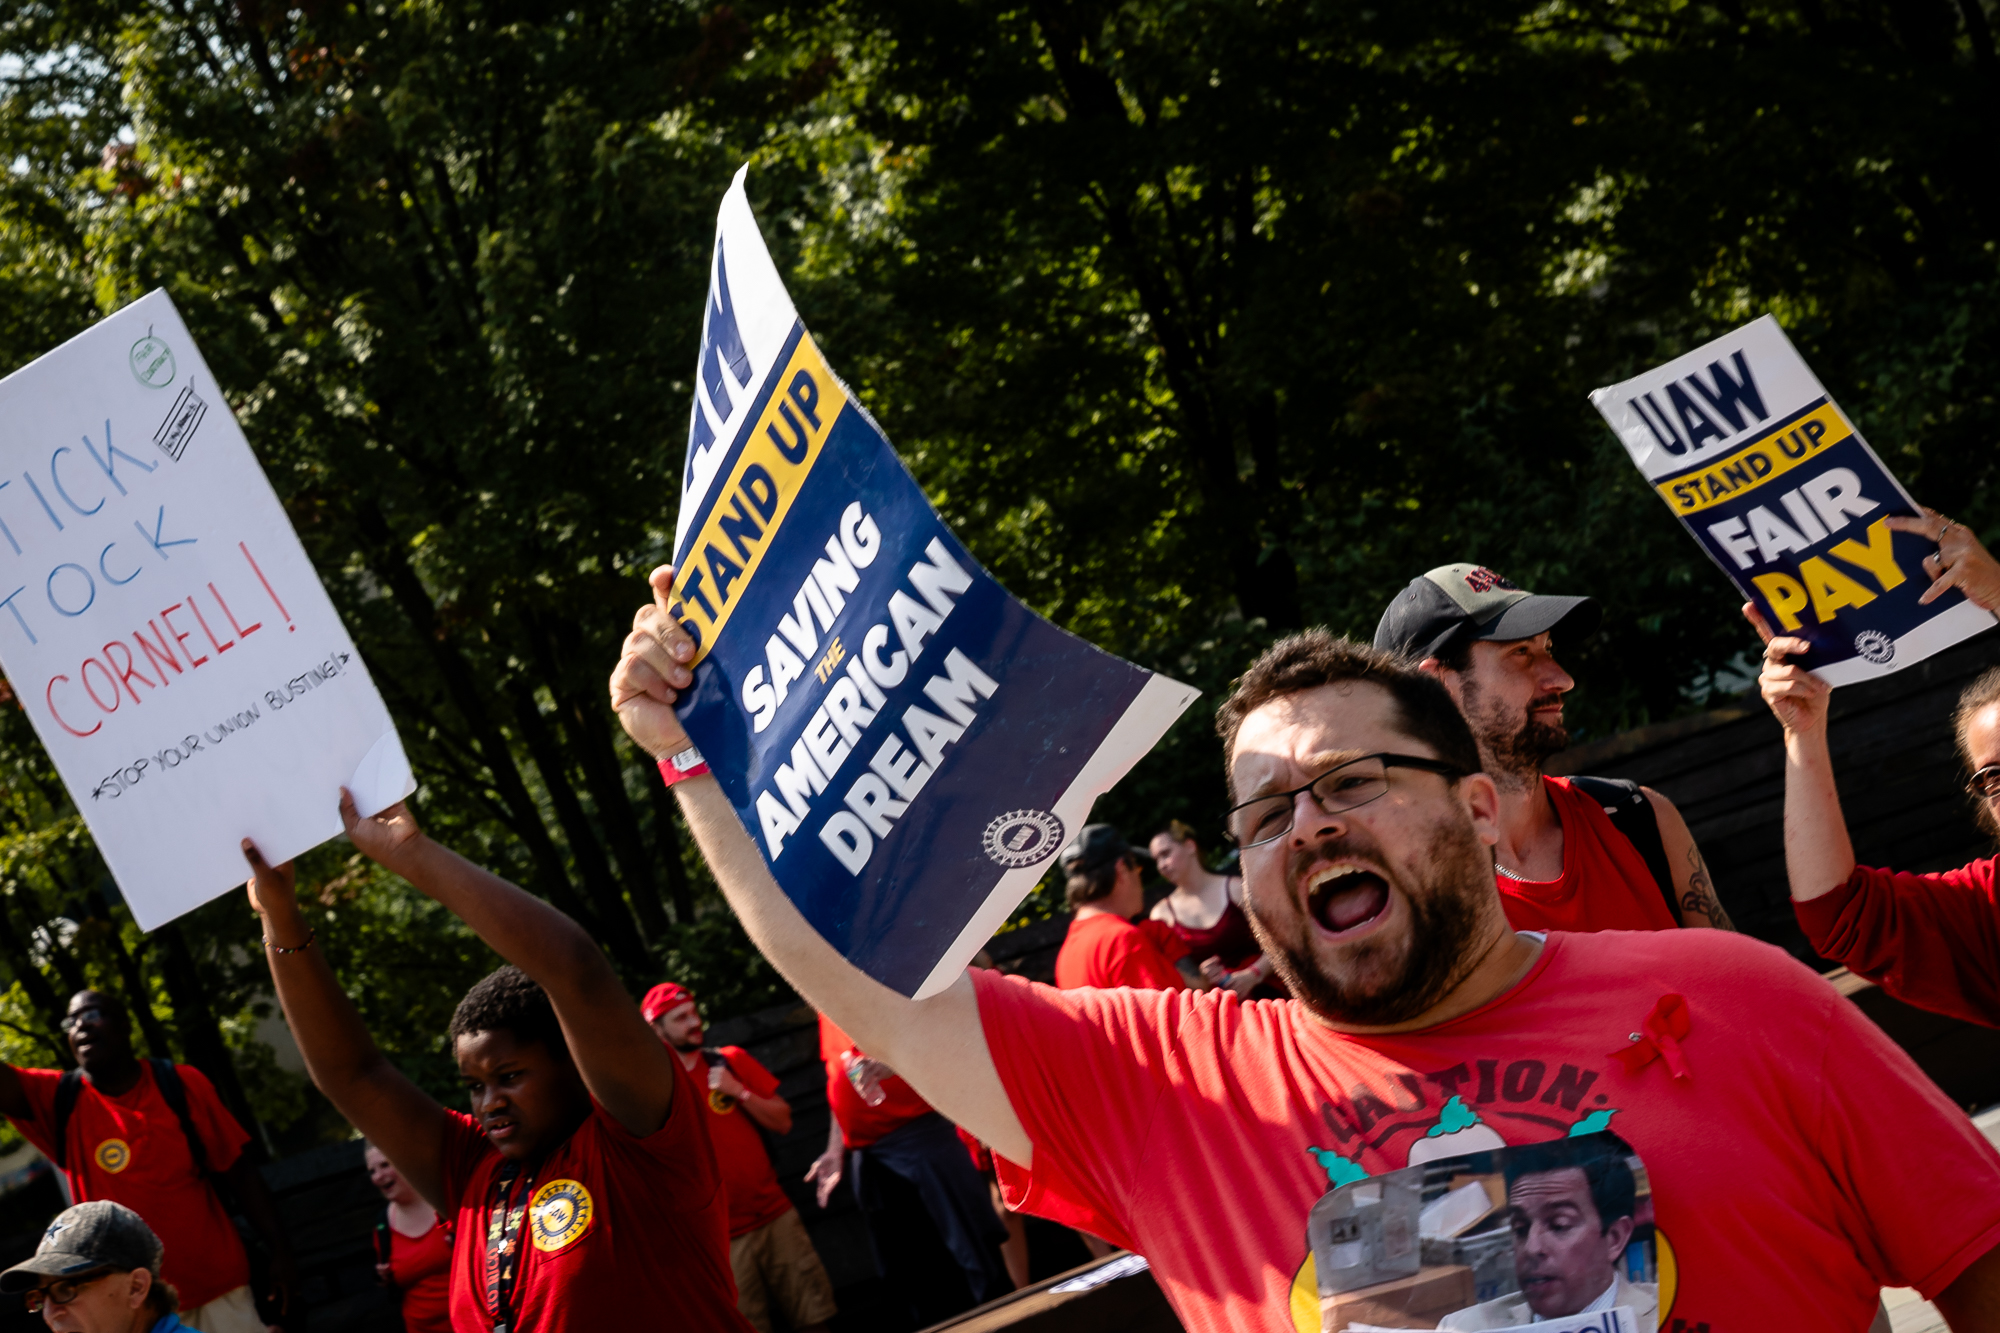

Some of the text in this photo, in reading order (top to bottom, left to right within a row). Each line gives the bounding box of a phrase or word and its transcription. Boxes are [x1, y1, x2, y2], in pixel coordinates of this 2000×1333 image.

[766, 368, 823, 465] UP
[1627, 348, 1772, 456] UAW
[1672, 417, 1828, 510] STAND UP
[1706, 466, 1881, 571] FAIR
[0, 505, 198, 645] TOCK
[741, 500, 882, 734] SAVING
[1751, 513, 1908, 633] PAY
[754, 536, 974, 863] AMERICAN
[812, 635, 847, 686] THE
[151, 734, 205, 772] YOUR
[203, 701, 261, 745] UNION
[818, 647, 1000, 877] DREAM
